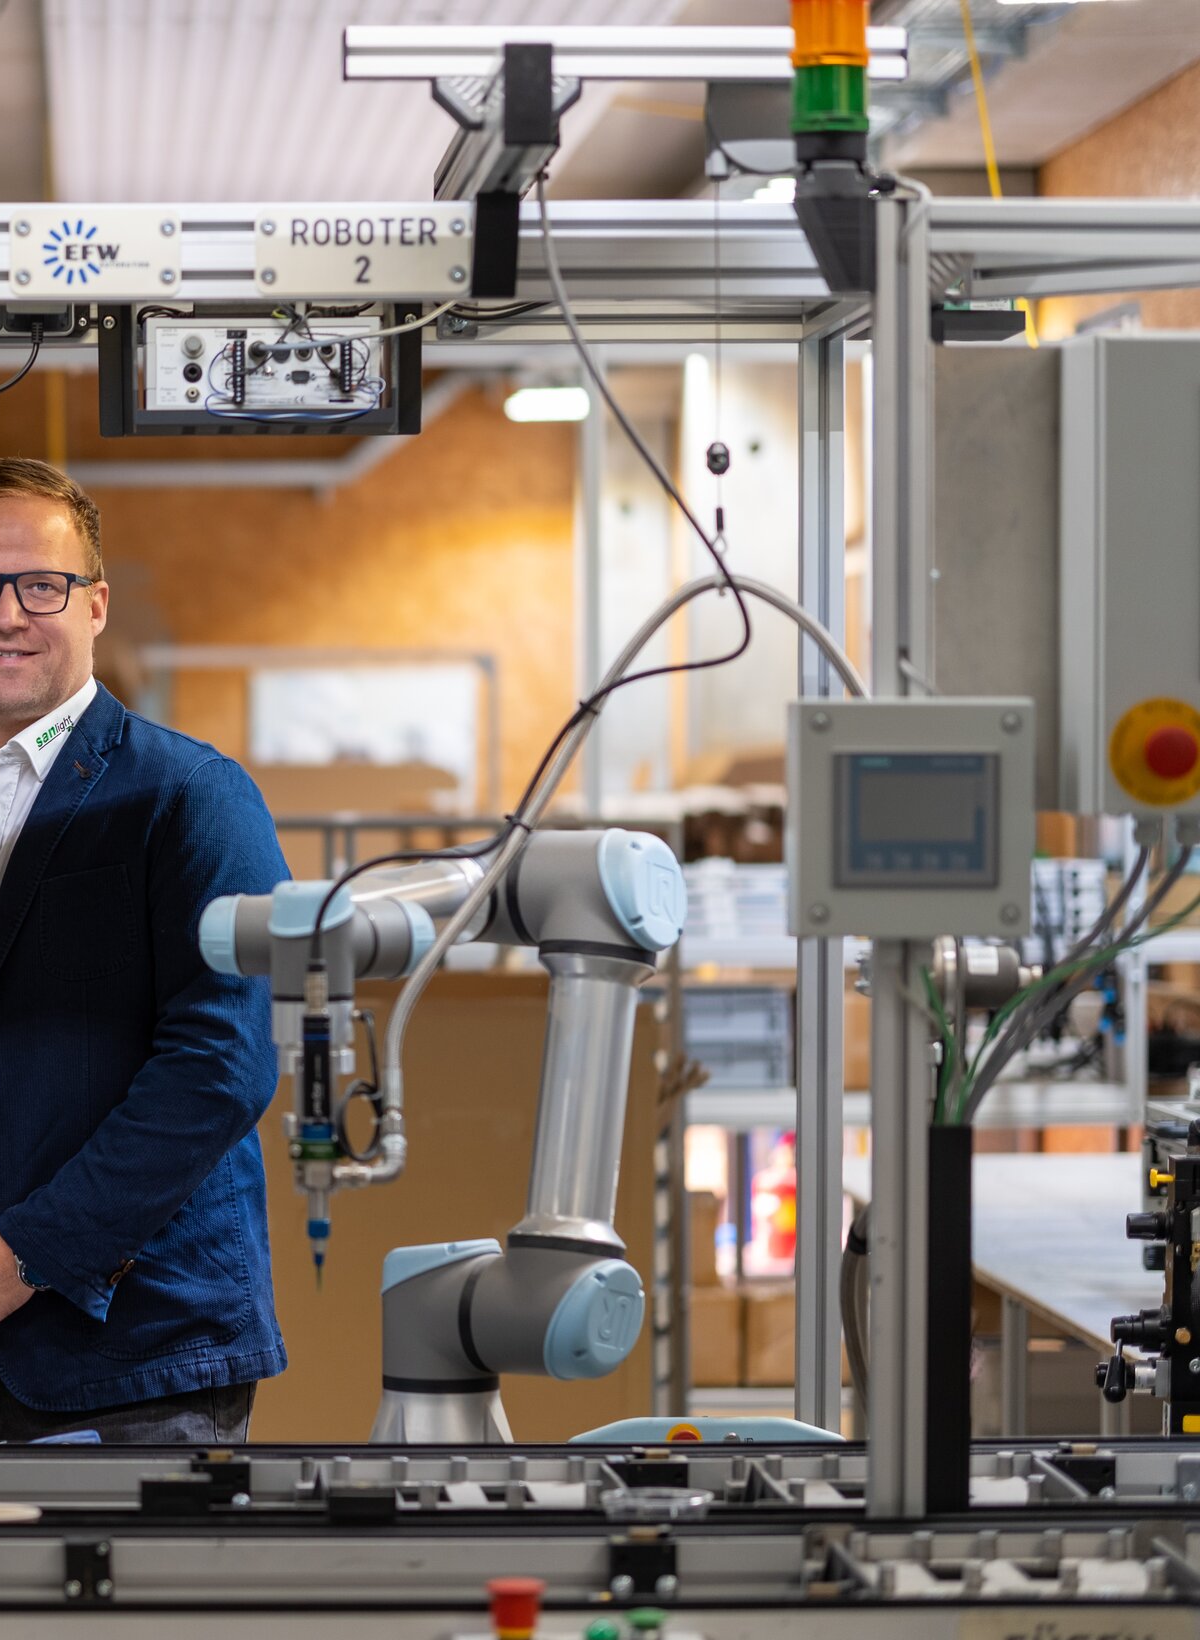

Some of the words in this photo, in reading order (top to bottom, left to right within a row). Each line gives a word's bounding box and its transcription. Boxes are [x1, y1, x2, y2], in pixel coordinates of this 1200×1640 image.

[290, 217, 438, 247] ROBOTER
[64, 243, 120, 261] EFW
[354, 254, 371, 284] 2
[35, 714, 73, 748] sanlight
